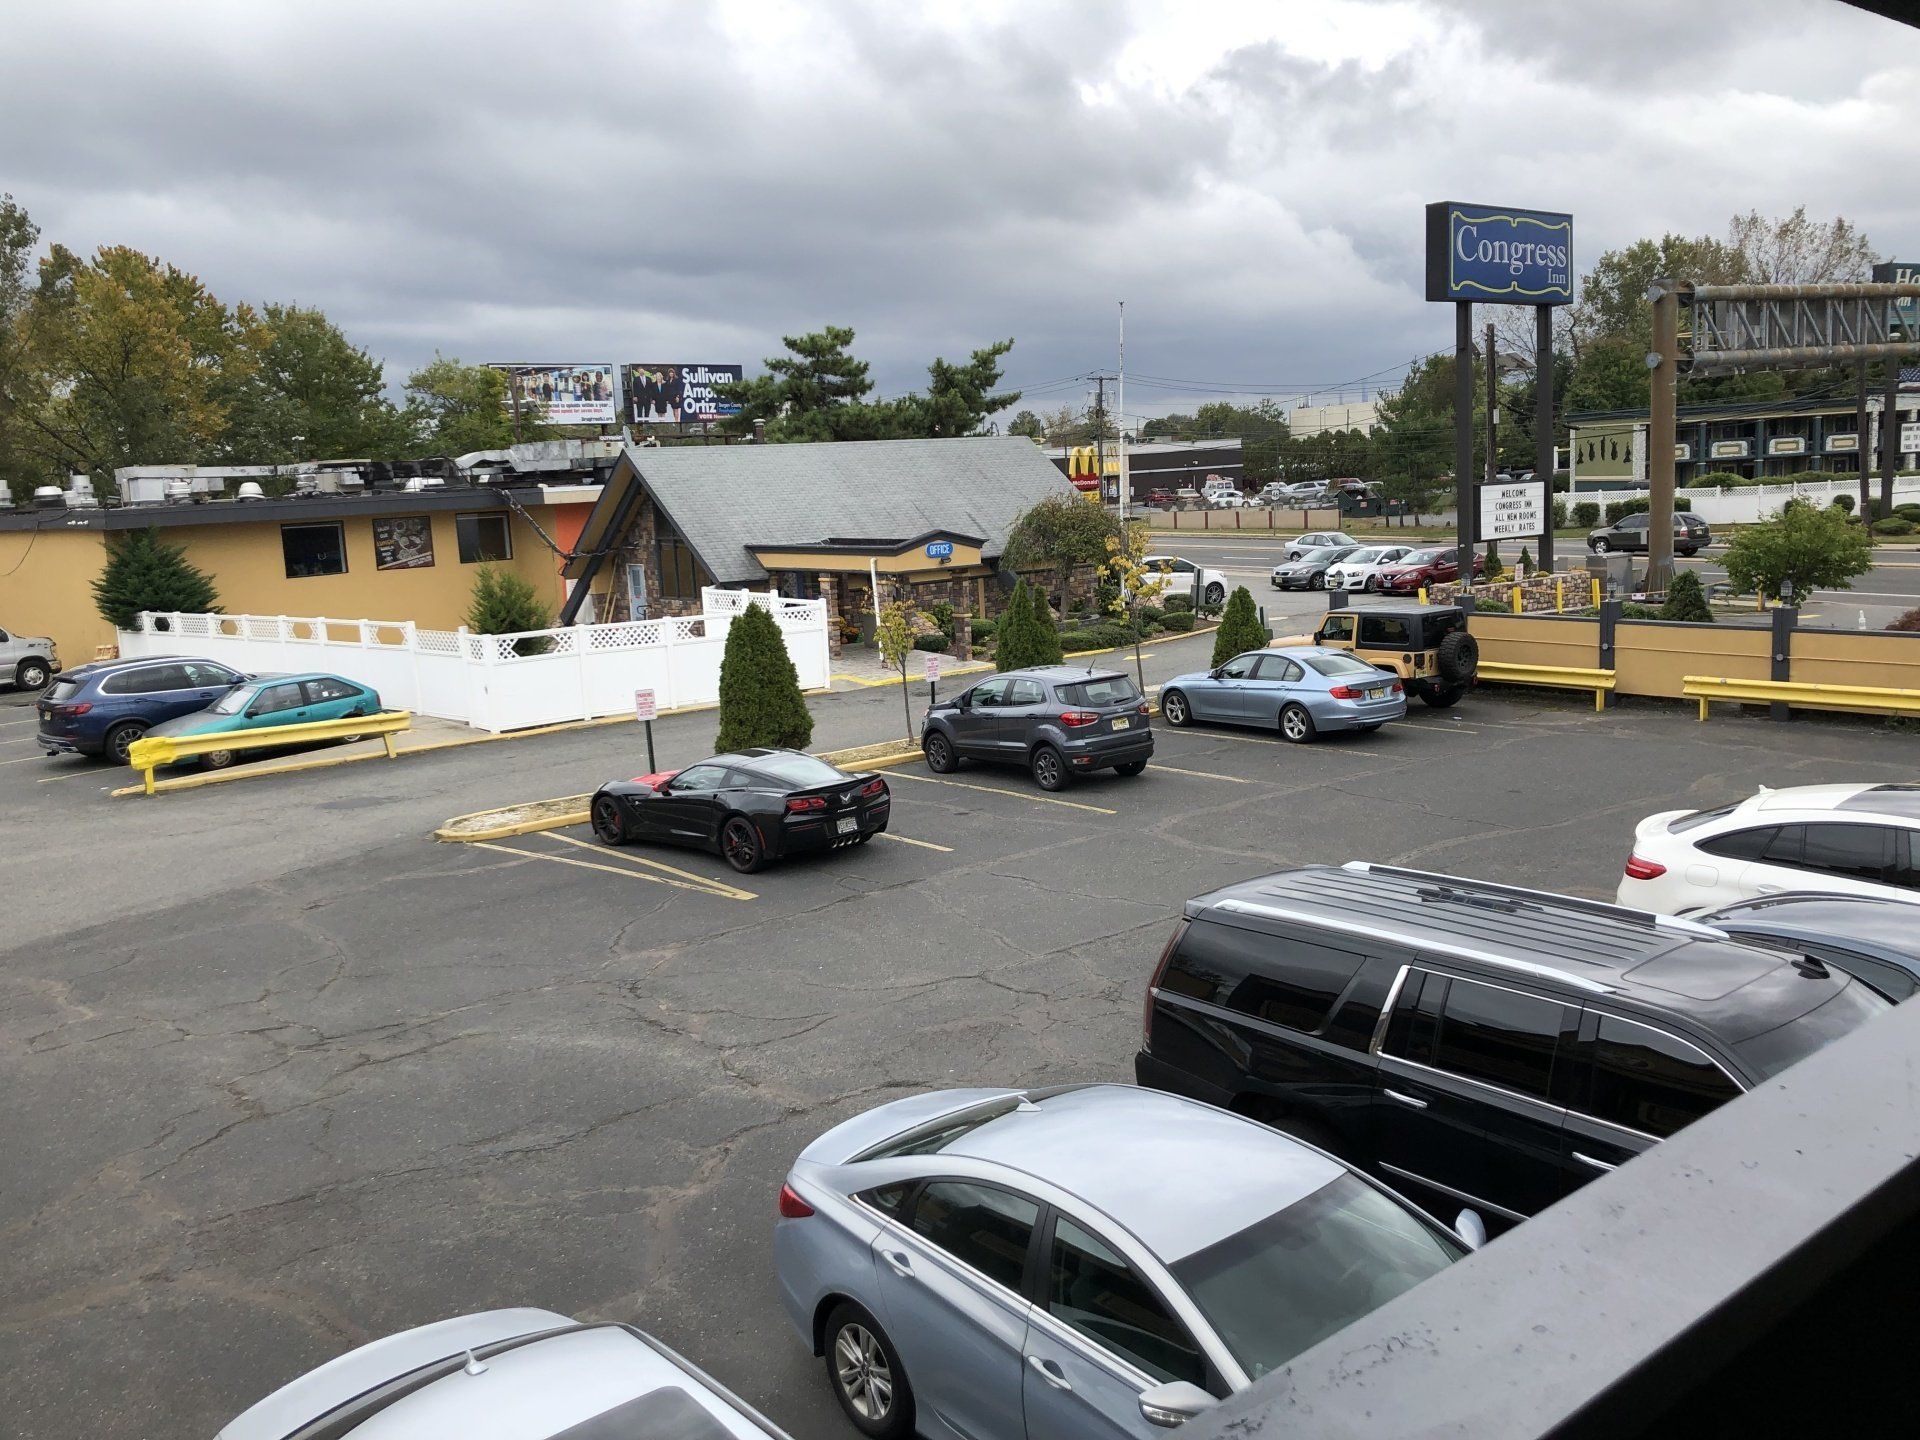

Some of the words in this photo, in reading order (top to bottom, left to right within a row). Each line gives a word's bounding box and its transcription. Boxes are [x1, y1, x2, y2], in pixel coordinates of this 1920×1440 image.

[1456, 225, 1567, 275] Congress
[1547, 268, 1566, 284] Inn
[682, 366, 733, 383] Sullivan
[683, 397, 717, 414] Ortiz
[1501, 489, 1526, 498] WELCOME
[1495, 501, 1521, 510] CONGRESS
[1495, 514, 1504, 522] ALL
[1519, 511, 1536, 520] ROOMS
[1494, 525, 1514, 533] WEEKLY
[1519, 522, 1535, 531] RATES
[929, 544, 951, 555] OFFICE
